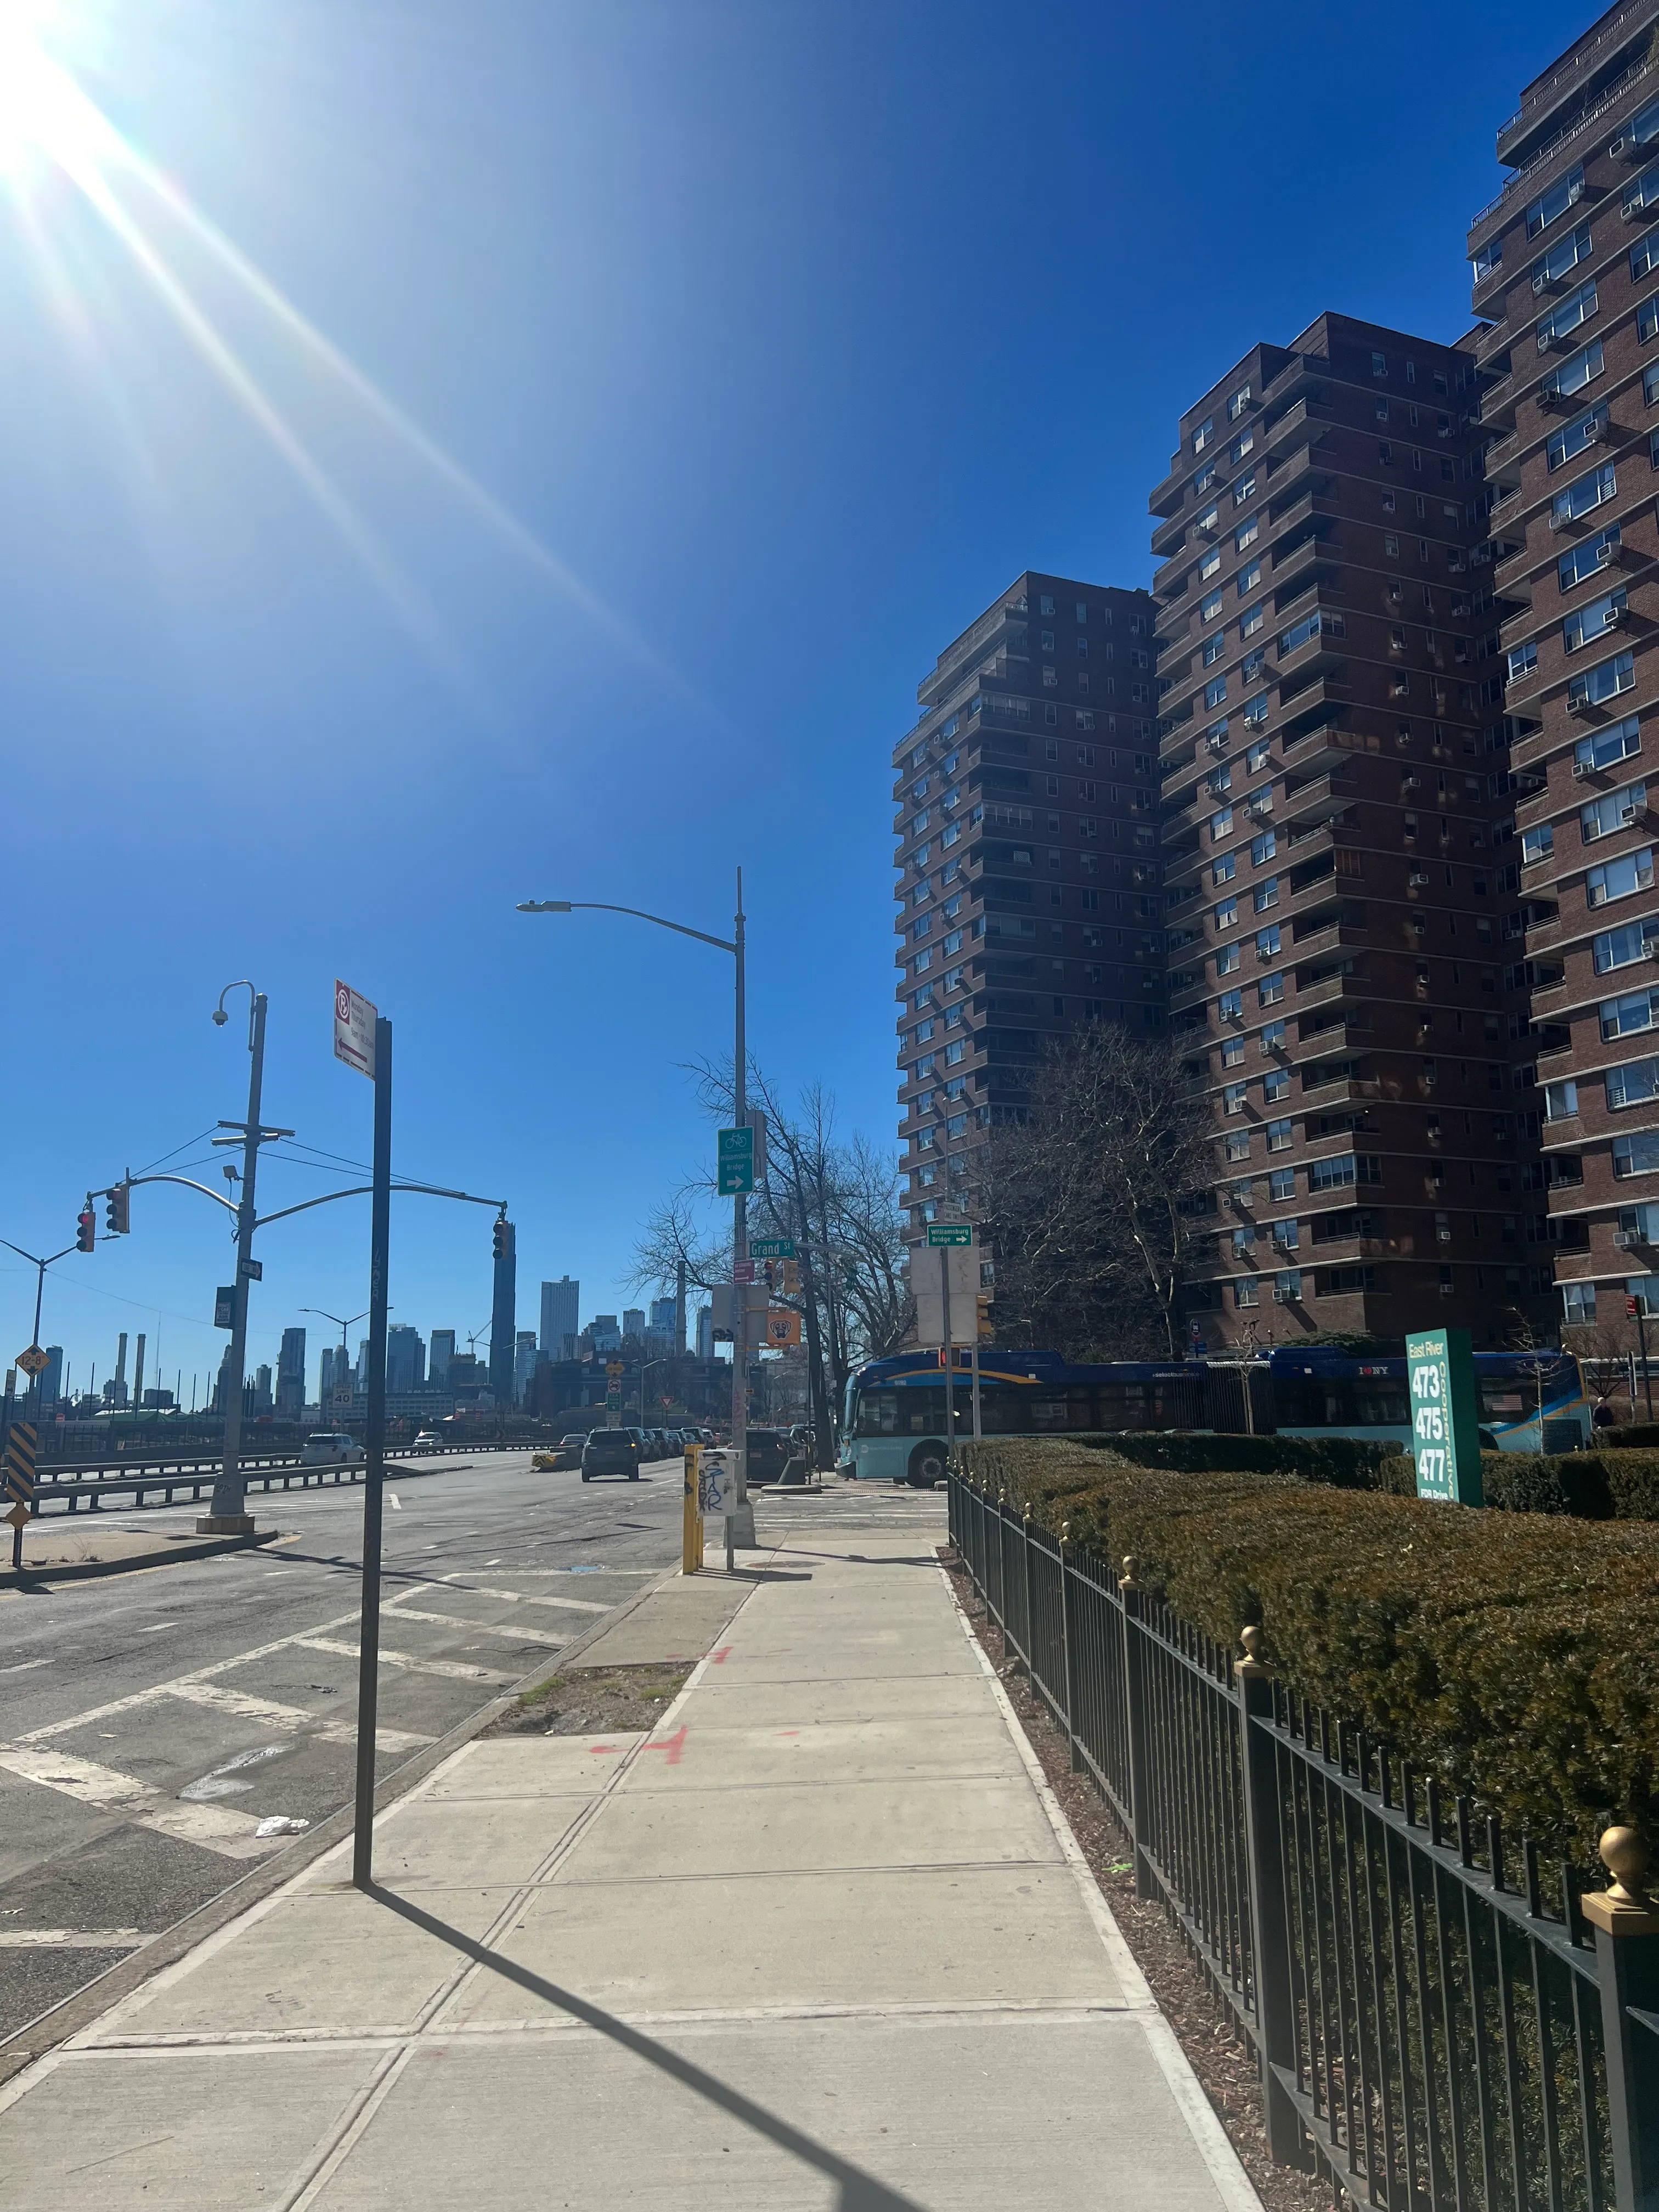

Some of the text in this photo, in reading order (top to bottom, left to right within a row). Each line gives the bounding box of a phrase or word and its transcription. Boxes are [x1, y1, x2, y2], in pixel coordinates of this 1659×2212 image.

[351, 1011, 366, 1030] Thursday
[720, 1153, 752, 1161] Williamsburg
[752, 1242, 790, 1255] Grand St
[1409, 1341, 1443, 1358] East River
[1372, 1367, 1389, 1375] NY
[1412, 1364, 1440, 1398] 473
[1415, 1407, 1443, 1440] 475
[1419, 1448, 1445, 1482] 477
[1432, 1489, 1448, 1500] Drive
